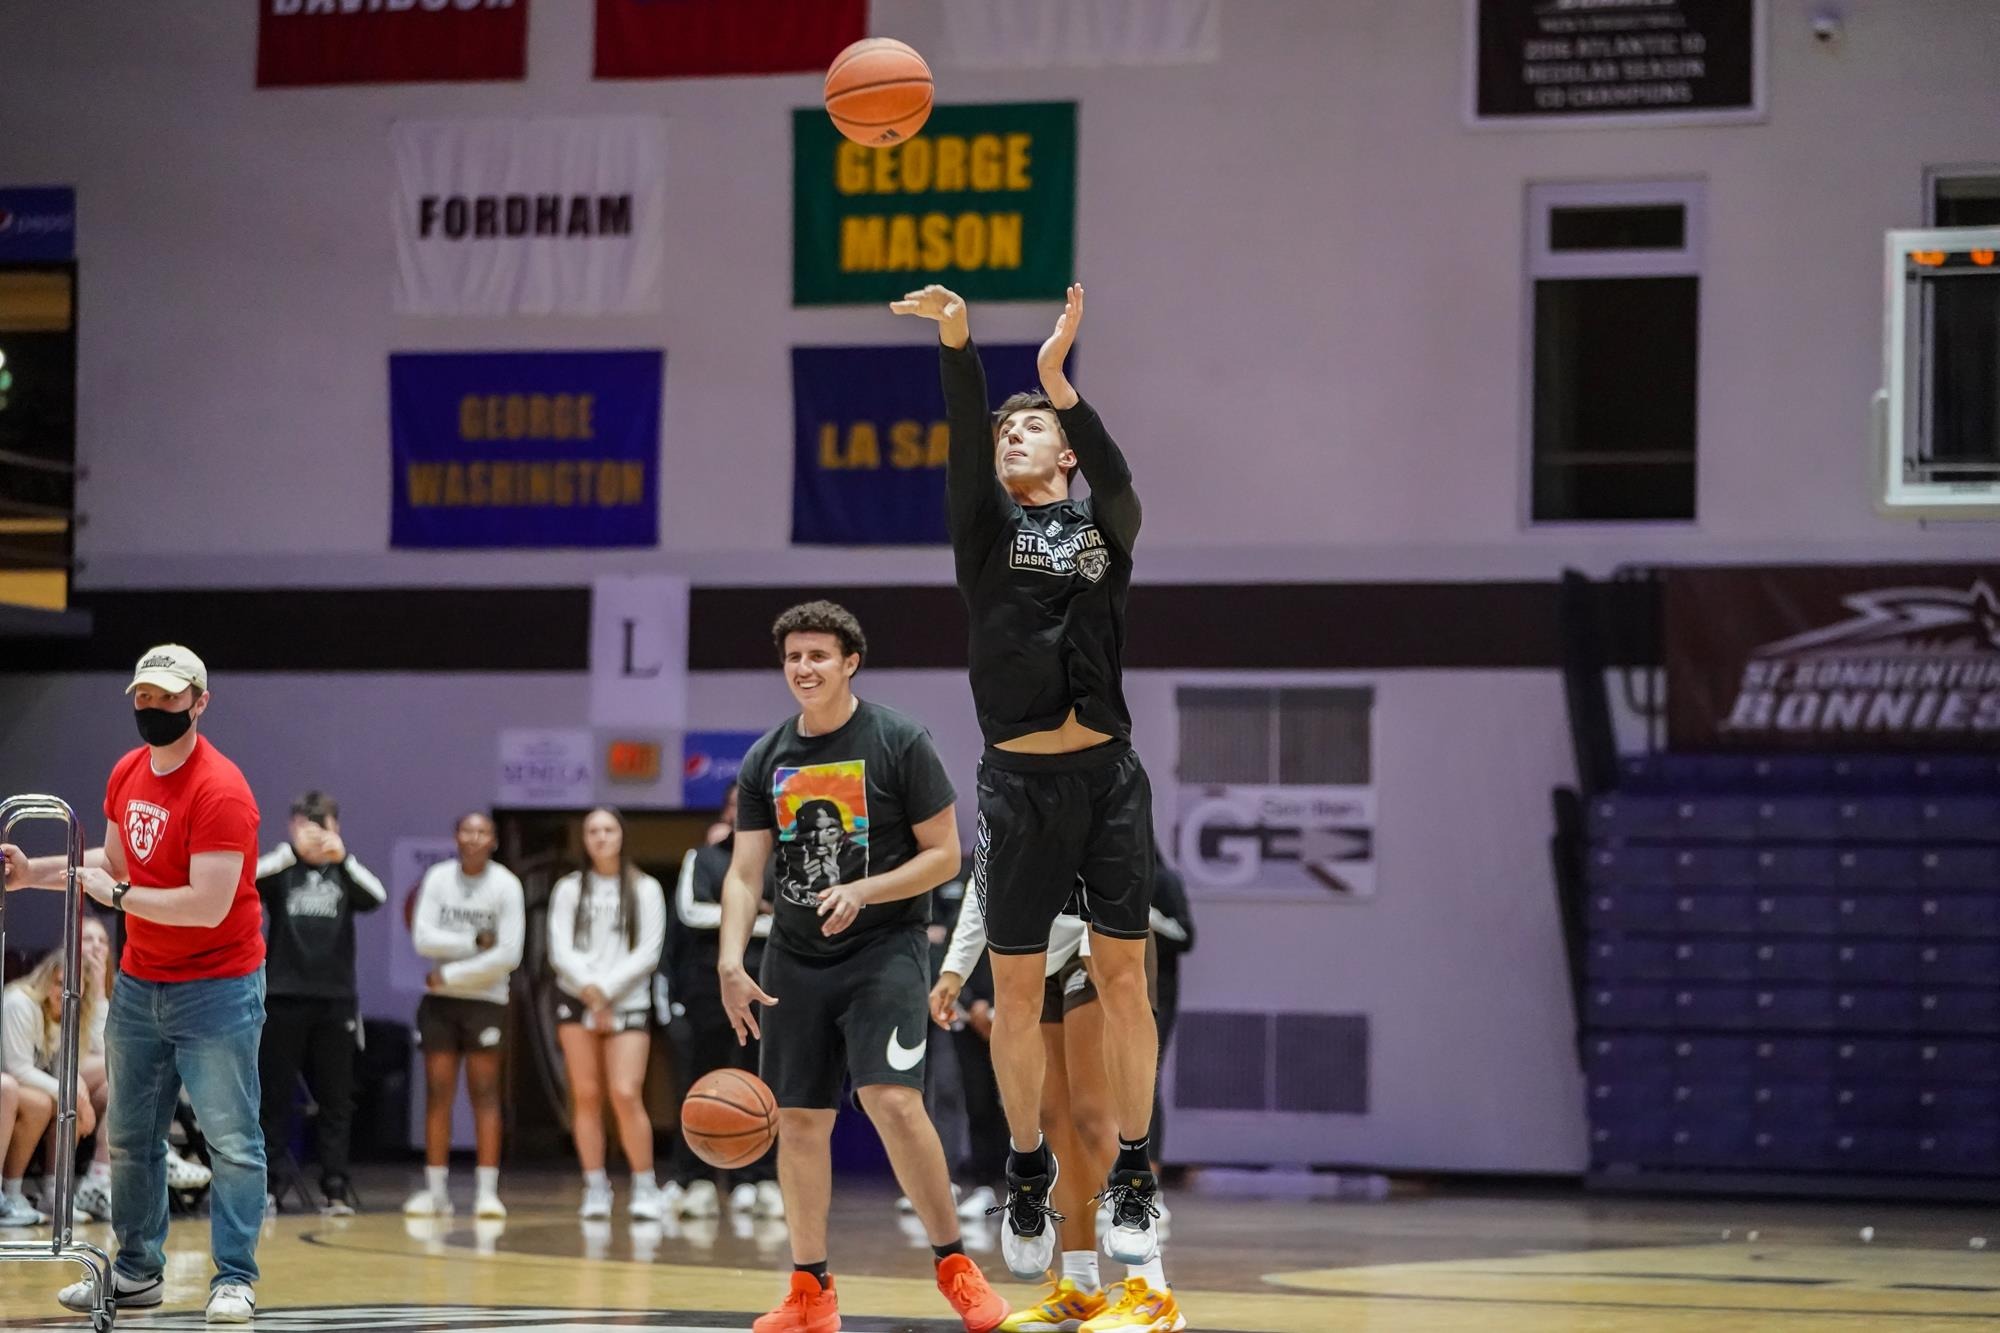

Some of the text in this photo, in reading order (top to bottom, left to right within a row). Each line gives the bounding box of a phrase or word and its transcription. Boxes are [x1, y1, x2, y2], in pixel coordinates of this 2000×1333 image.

[836, 132, 1032, 195] GEORGE
[418, 194, 634, 241] FORDHAM
[839, 212, 1023, 272] MASON
[459, 393, 595, 441] GEORGE
[819, 421, 881, 471] LA
[408, 459, 644, 508] WASHINGTON
[1015, 553, 1076, 571] BASKEBALL
[621, 616, 662, 678] L
[1794, 656, 2000, 689] BONAVENTUR
[1728, 690, 2000, 731] BONNIES
